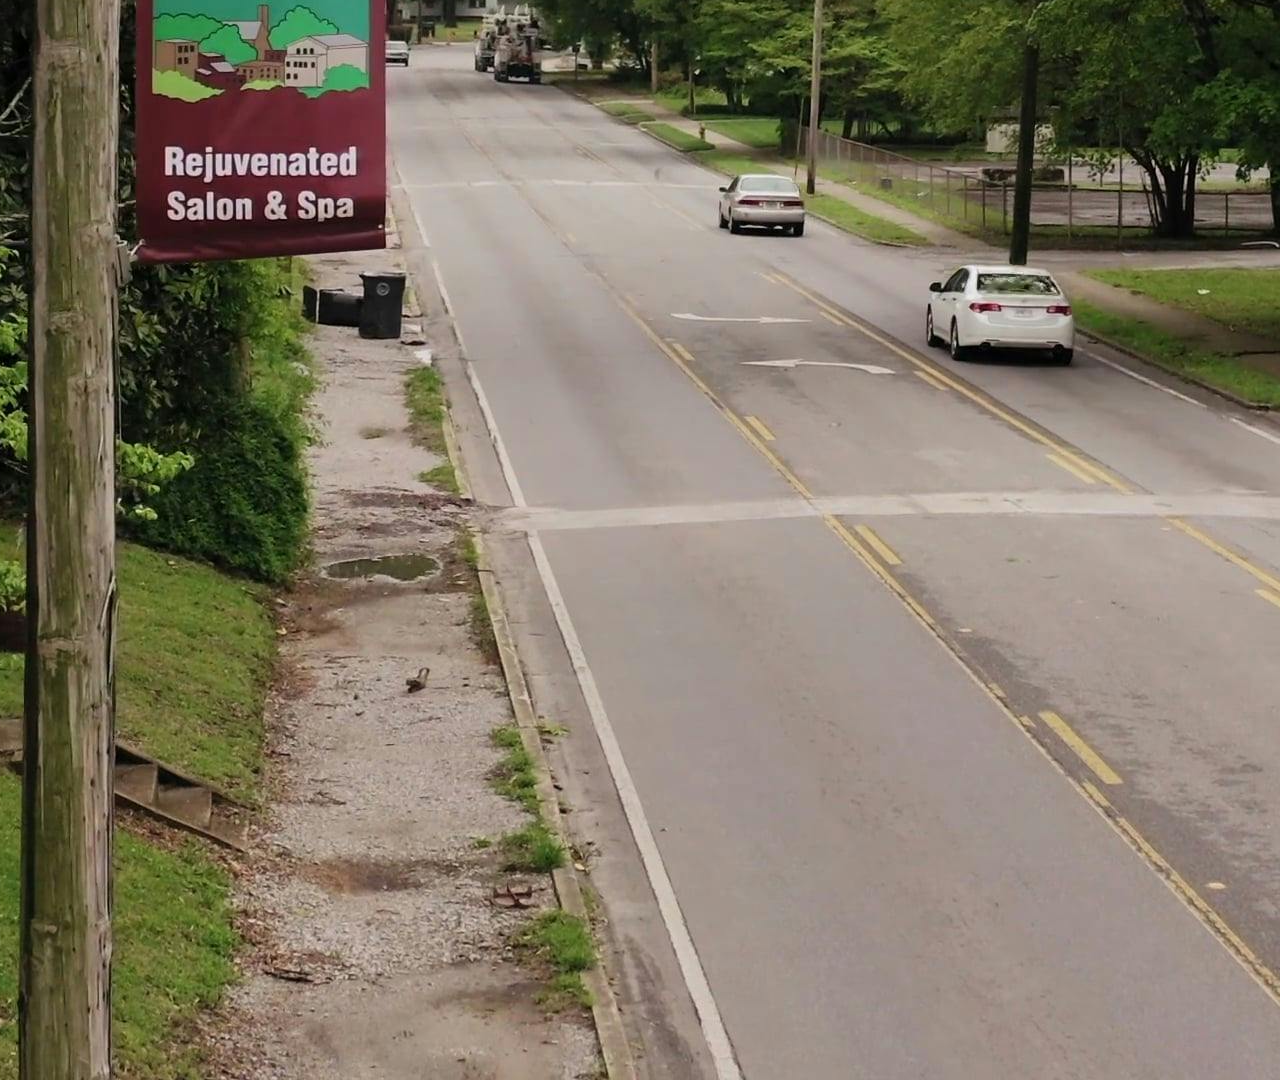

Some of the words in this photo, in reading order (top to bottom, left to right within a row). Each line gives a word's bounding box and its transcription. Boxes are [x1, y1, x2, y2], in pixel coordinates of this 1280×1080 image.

[164, 146, 357, 183] Rejuvenated
[166, 190, 253, 220] Salon
[264, 190, 288, 220] &
[297, 190, 355, 222] Spa
